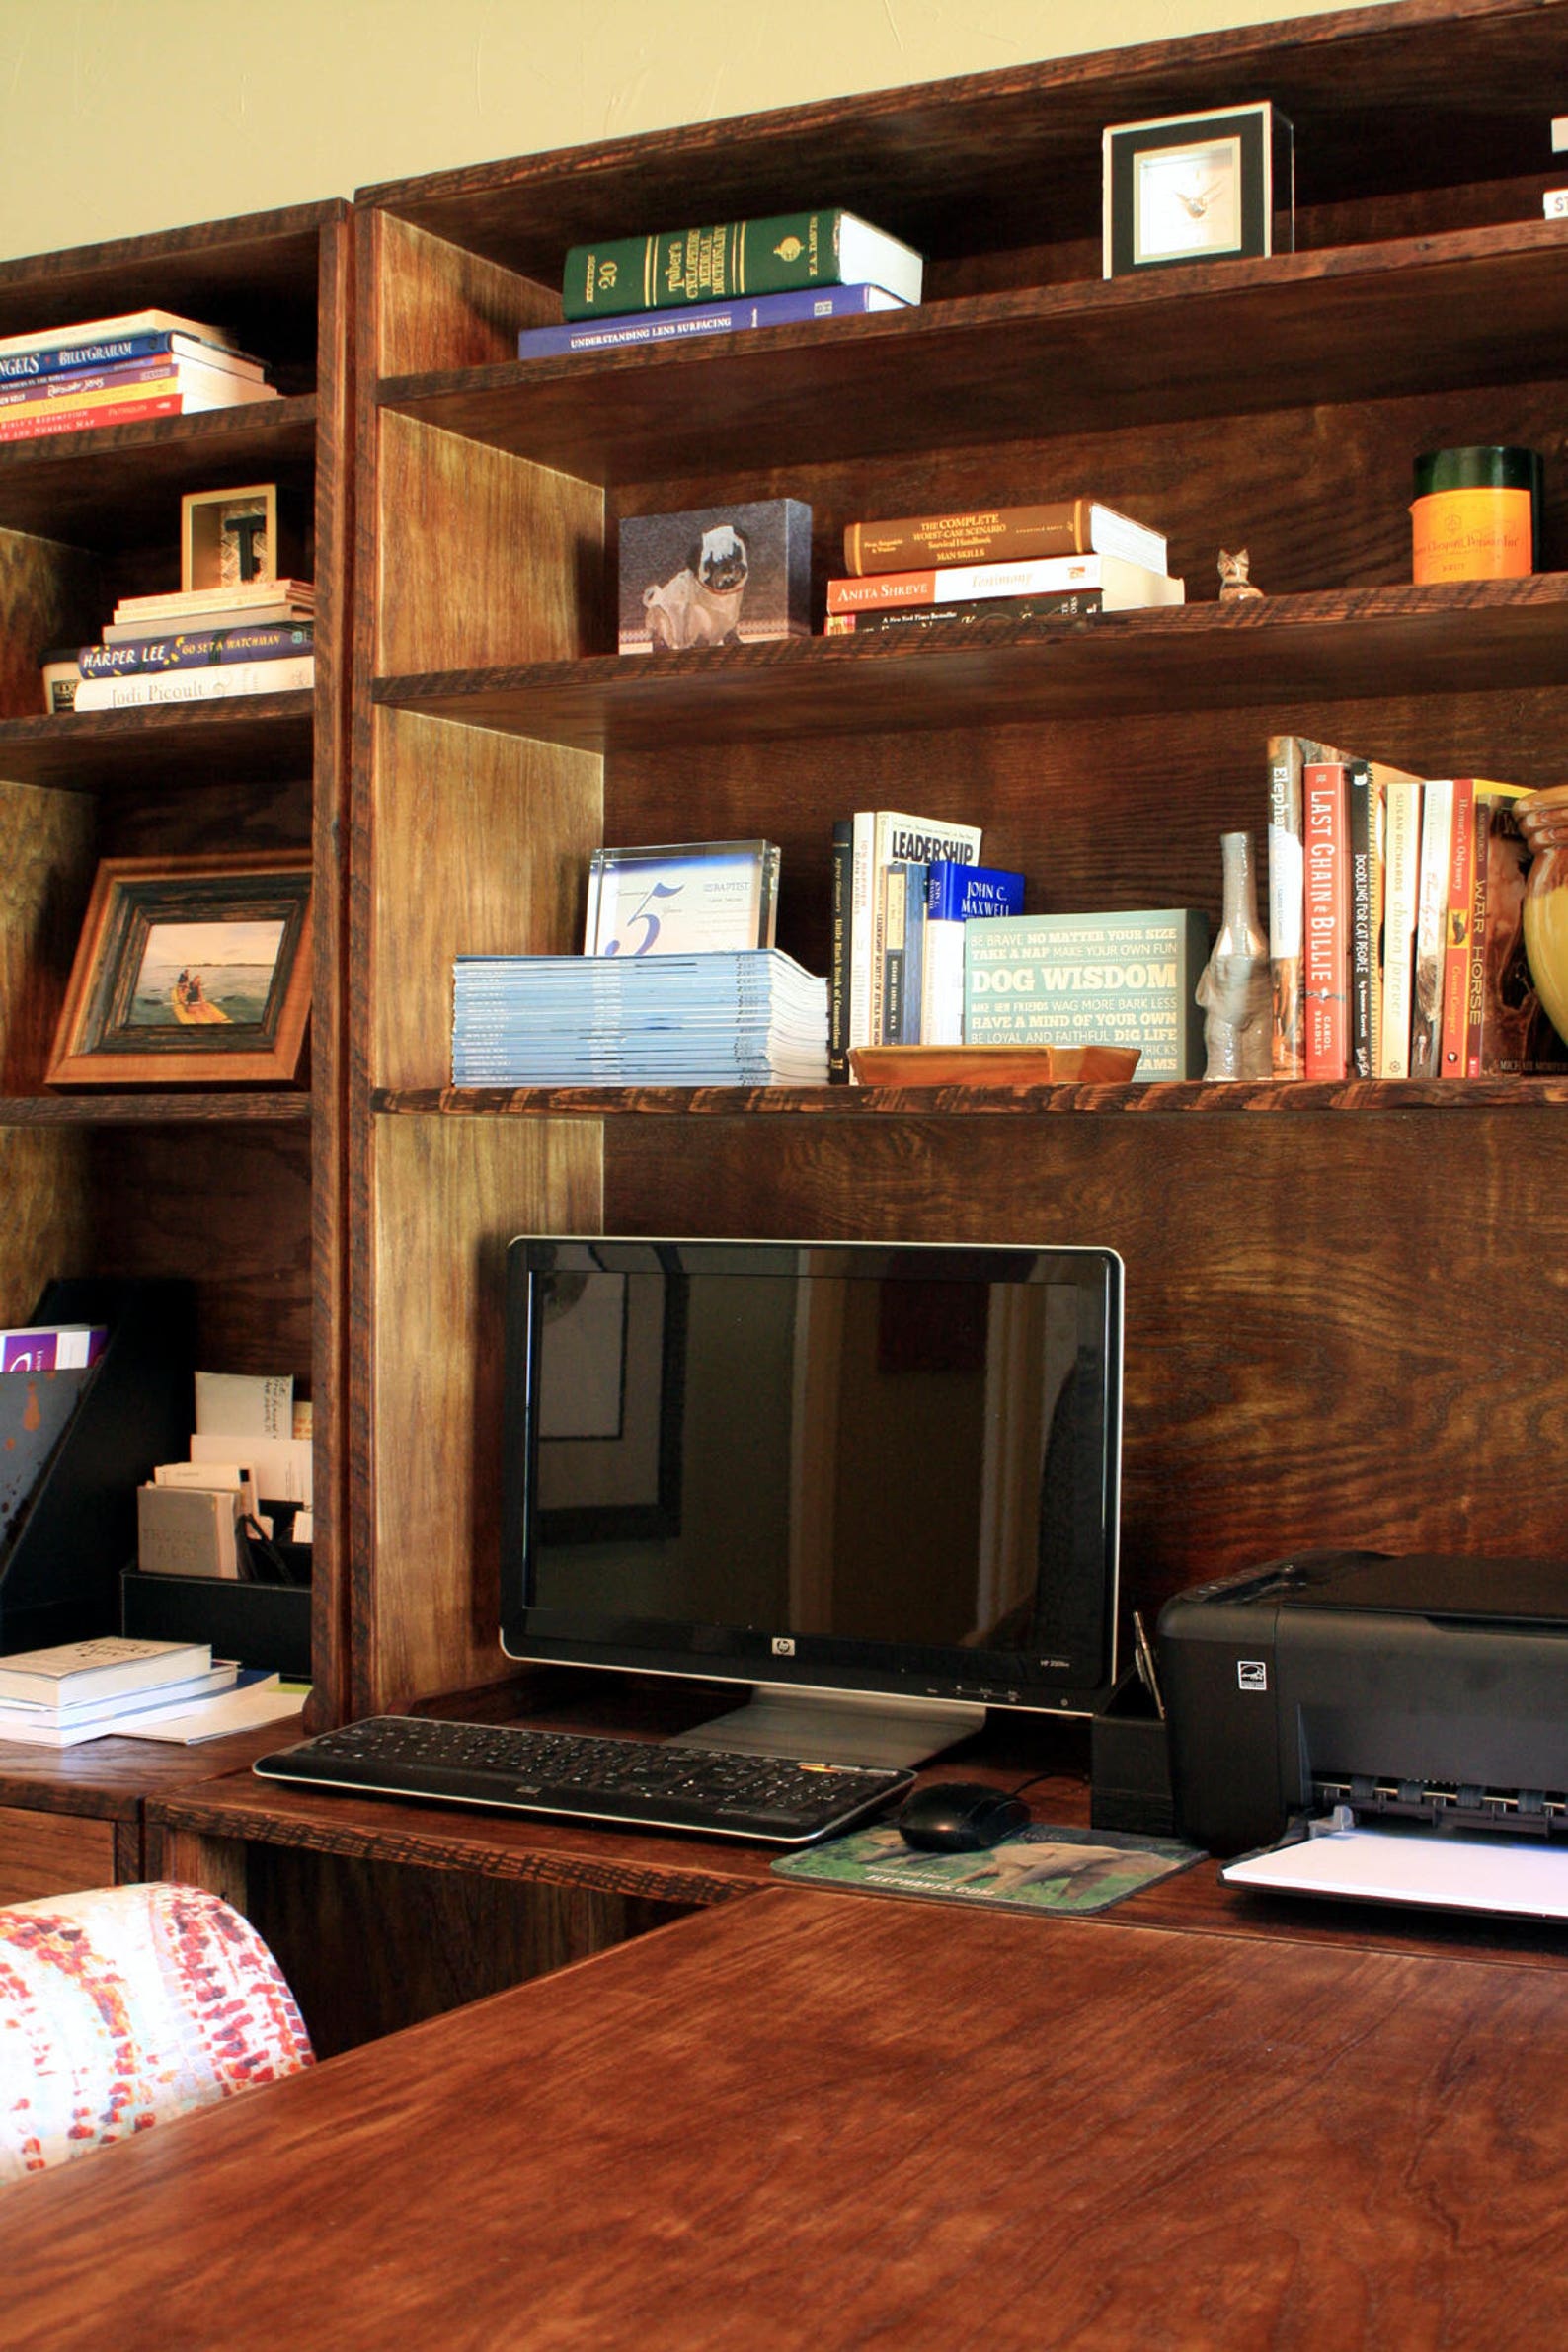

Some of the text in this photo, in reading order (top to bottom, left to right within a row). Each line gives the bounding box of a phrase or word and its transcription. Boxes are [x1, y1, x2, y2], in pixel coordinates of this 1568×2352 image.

[667, 241, 685, 292] Taber's
[699, 234, 713, 288] MEDICAL
[712, 225, 727, 296] DICTIONARY
[598, 261, 618, 290] 20
[570, 327, 650, 349] UNDERSTANDING
[652, 323, 675, 340] LENS
[677, 316, 732, 336] SURFACING
[939, 513, 999, 530] COMPLETE
[937, 548, 985, 561] MAN SKILLS
[837, 588, 878, 602] ANITA
[880, 584, 928, 598] SHREVE
[83, 648, 137, 668] HARPER
[142, 645, 166, 662] LEE
[182, 644, 196, 655] GO
[197, 641, 215, 654] SET
[226, 634, 281, 649] WATCHMAN
[112, 681, 204, 708] Jodi Picoult
[892, 830, 974, 865] LEADERSHIP
[967, 881, 993, 898] JOHN
[1310, 790, 1336, 980] LAST CHAIN BILLIE
[1355, 854, 1368, 901] DOODLING
[961, 898, 1010, 916] MAXWELL
[1355, 902, 1367, 922] FOR
[1389, 793, 1408, 1018] SUSAN RICHARDS chosen forever
[1448, 798, 1468, 1035] Homer's Odyssey Gwen Cooper
[1472, 879, 1486, 933] WAR
[834, 919, 843, 941] Little
[988, 934, 1022, 947] BRAVE
[1027, 933, 1046, 944] NO
[1049, 931, 1105, 943] MATTER
[1107, 930, 1143, 941] YOUR
[1145, 928, 1177, 940] SIZE
[1355, 922, 1367, 940] CAT
[834, 942, 843, 965] Black
[971, 942, 1177, 960] TAKE A NAP MAKE YOUR OWN FUN
[1356, 941, 1368, 973] PEOPLE
[833, 966, 843, 988] Book
[971, 963, 1177, 993] DOG WISDOM
[1469, 945, 1485, 1026] HORSE
[833, 989, 843, 999] of
[1053, 1000, 1079, 1011] WAG
[1082, 999, 1116, 1011] MORE
[1119, 998, 1148, 1010] BARK
[1151, 997, 1178, 1009] LESS
[832, 1000, 842, 1049] Connections
[972, 1012, 1177, 1029] HAVE A MIND OF YOUR OWN
[1314, 1010, 1323, 1057] BRADLEY
[972, 1032, 985, 1045] BE
[988, 1032, 1022, 1044] LOYAL
[1026, 1031, 1052, 1043] AND
[1055, 1029, 1110, 1042] FAITHFUL
[1144, 1028, 1178, 1041] LIFE
